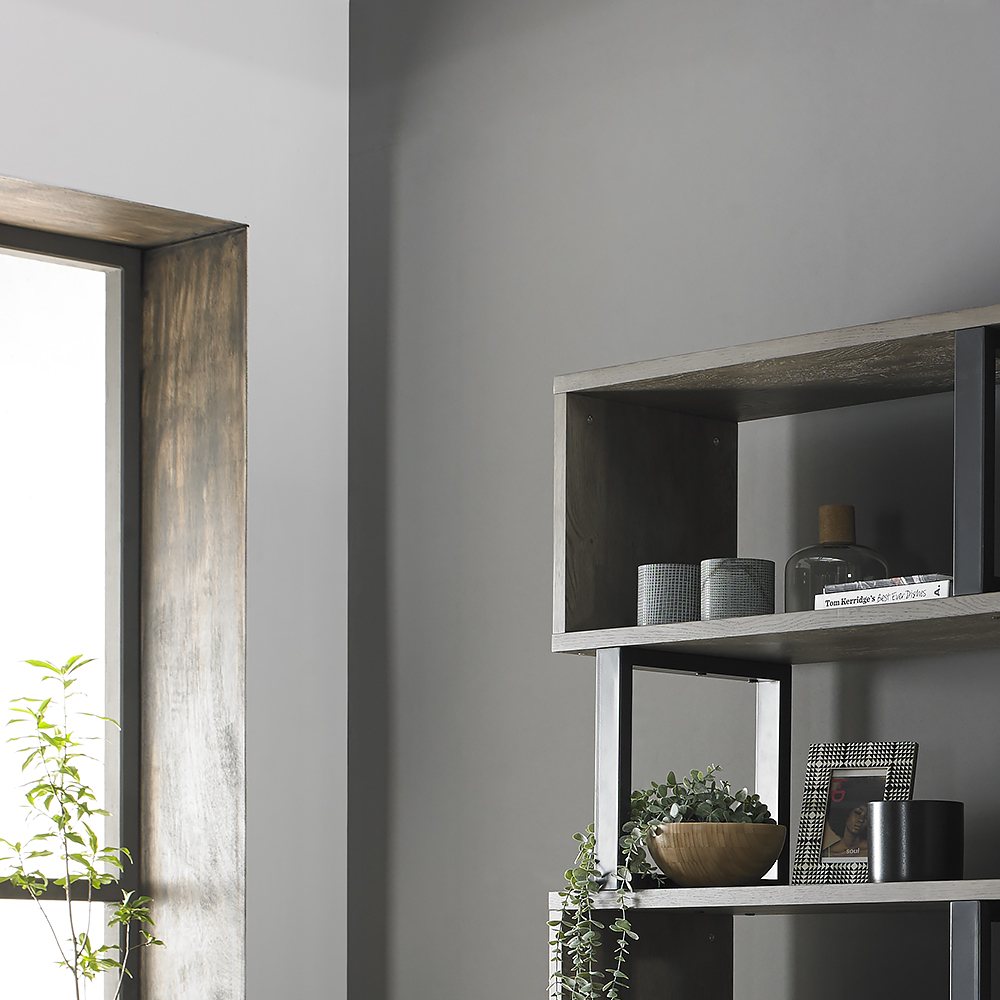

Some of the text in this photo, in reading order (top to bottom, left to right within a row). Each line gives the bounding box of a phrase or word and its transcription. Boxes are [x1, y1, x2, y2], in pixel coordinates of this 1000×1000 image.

[825, 589, 927, 607] Tom Kerridge's Best Ever Dishes
